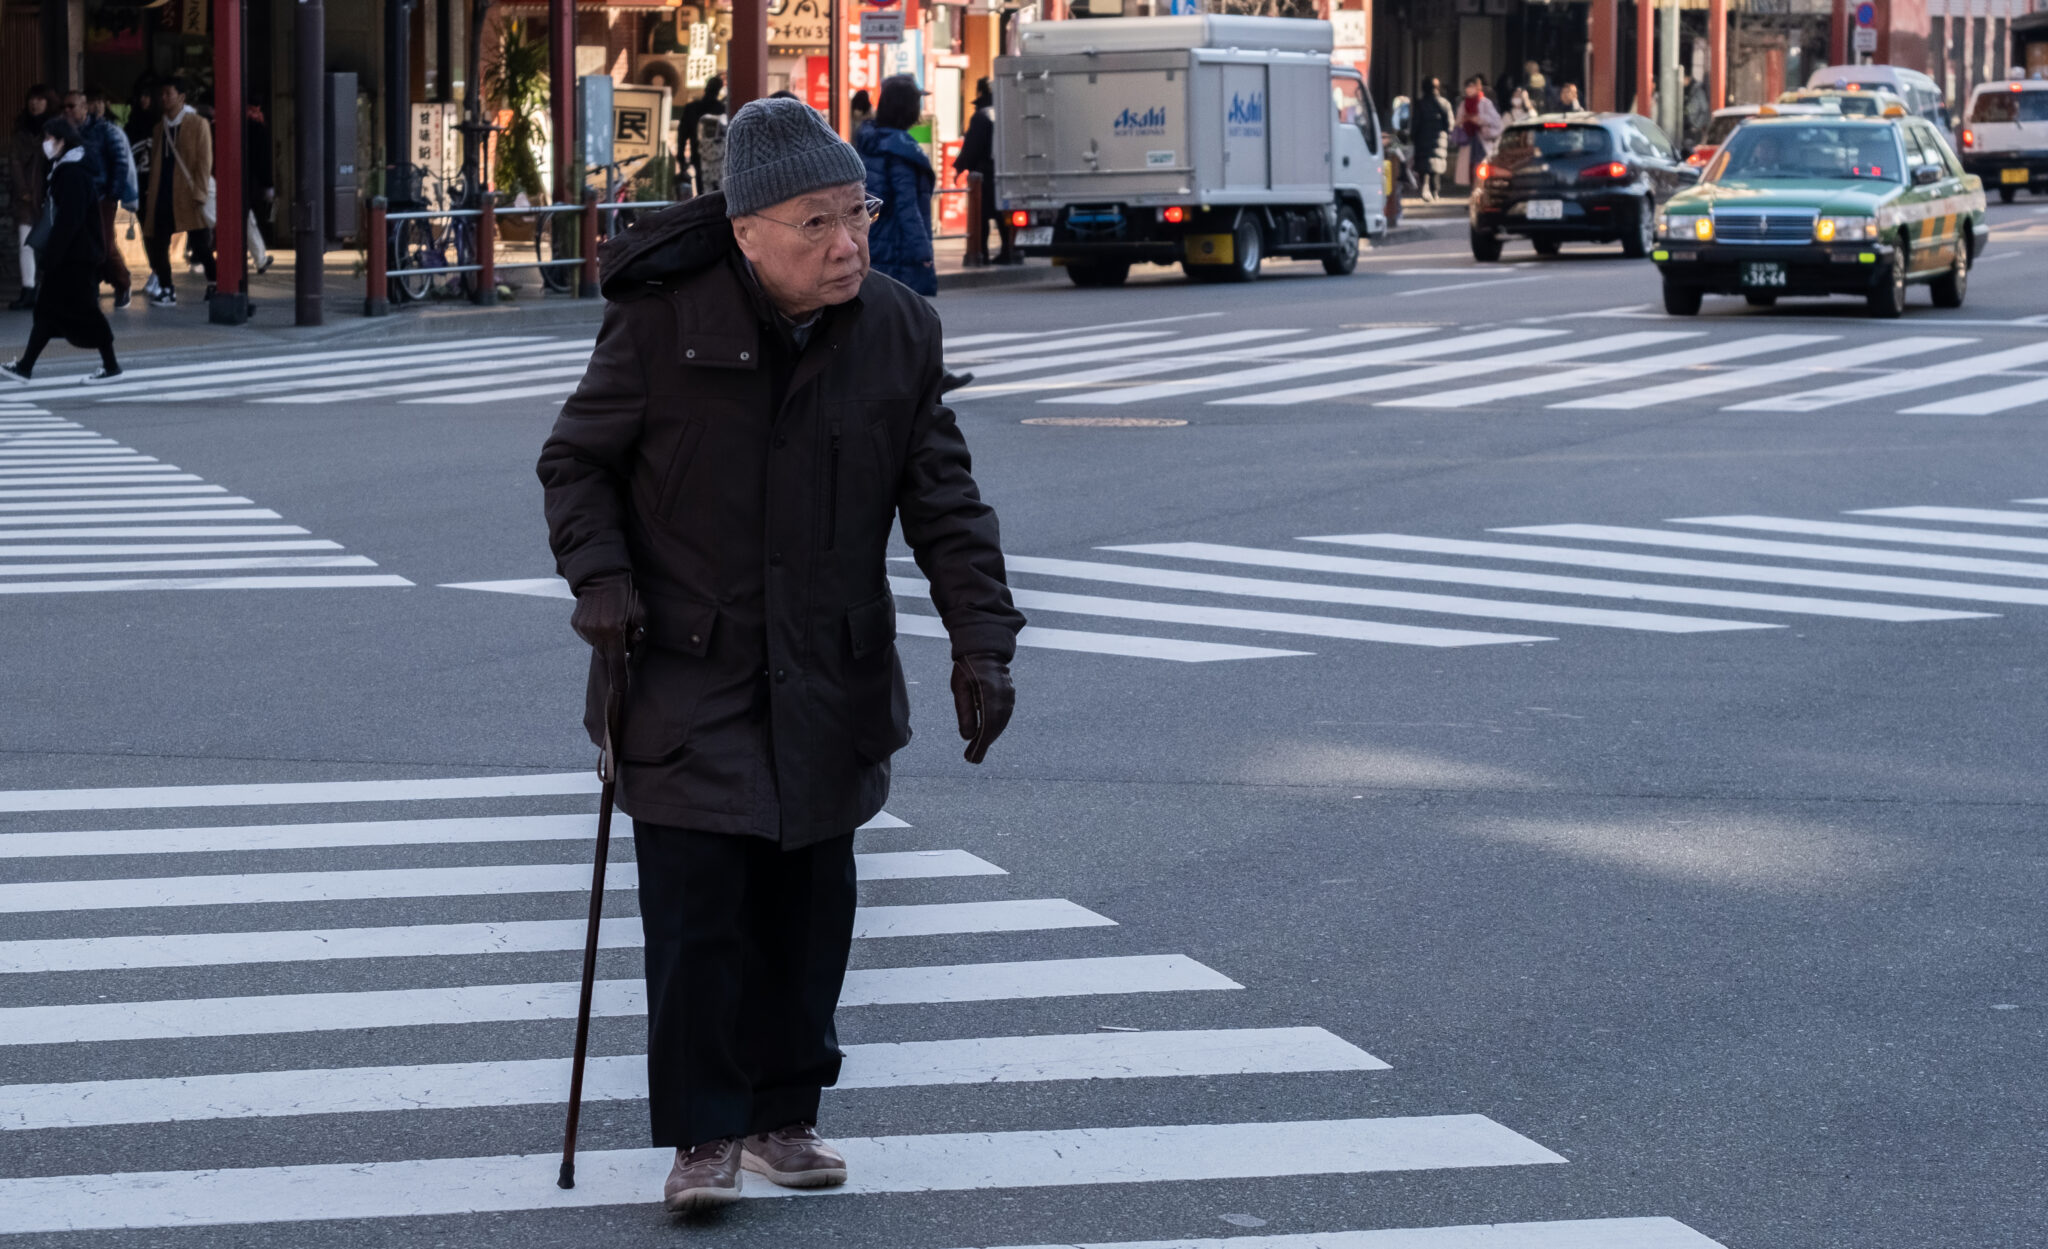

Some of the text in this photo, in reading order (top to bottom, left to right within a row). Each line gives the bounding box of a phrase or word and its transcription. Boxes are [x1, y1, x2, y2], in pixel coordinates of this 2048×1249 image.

[1114, 106, 1166, 128] Asahi
[1228, 91, 1262, 124] Asahi
[1750, 270, 1786, 286] 36-64
